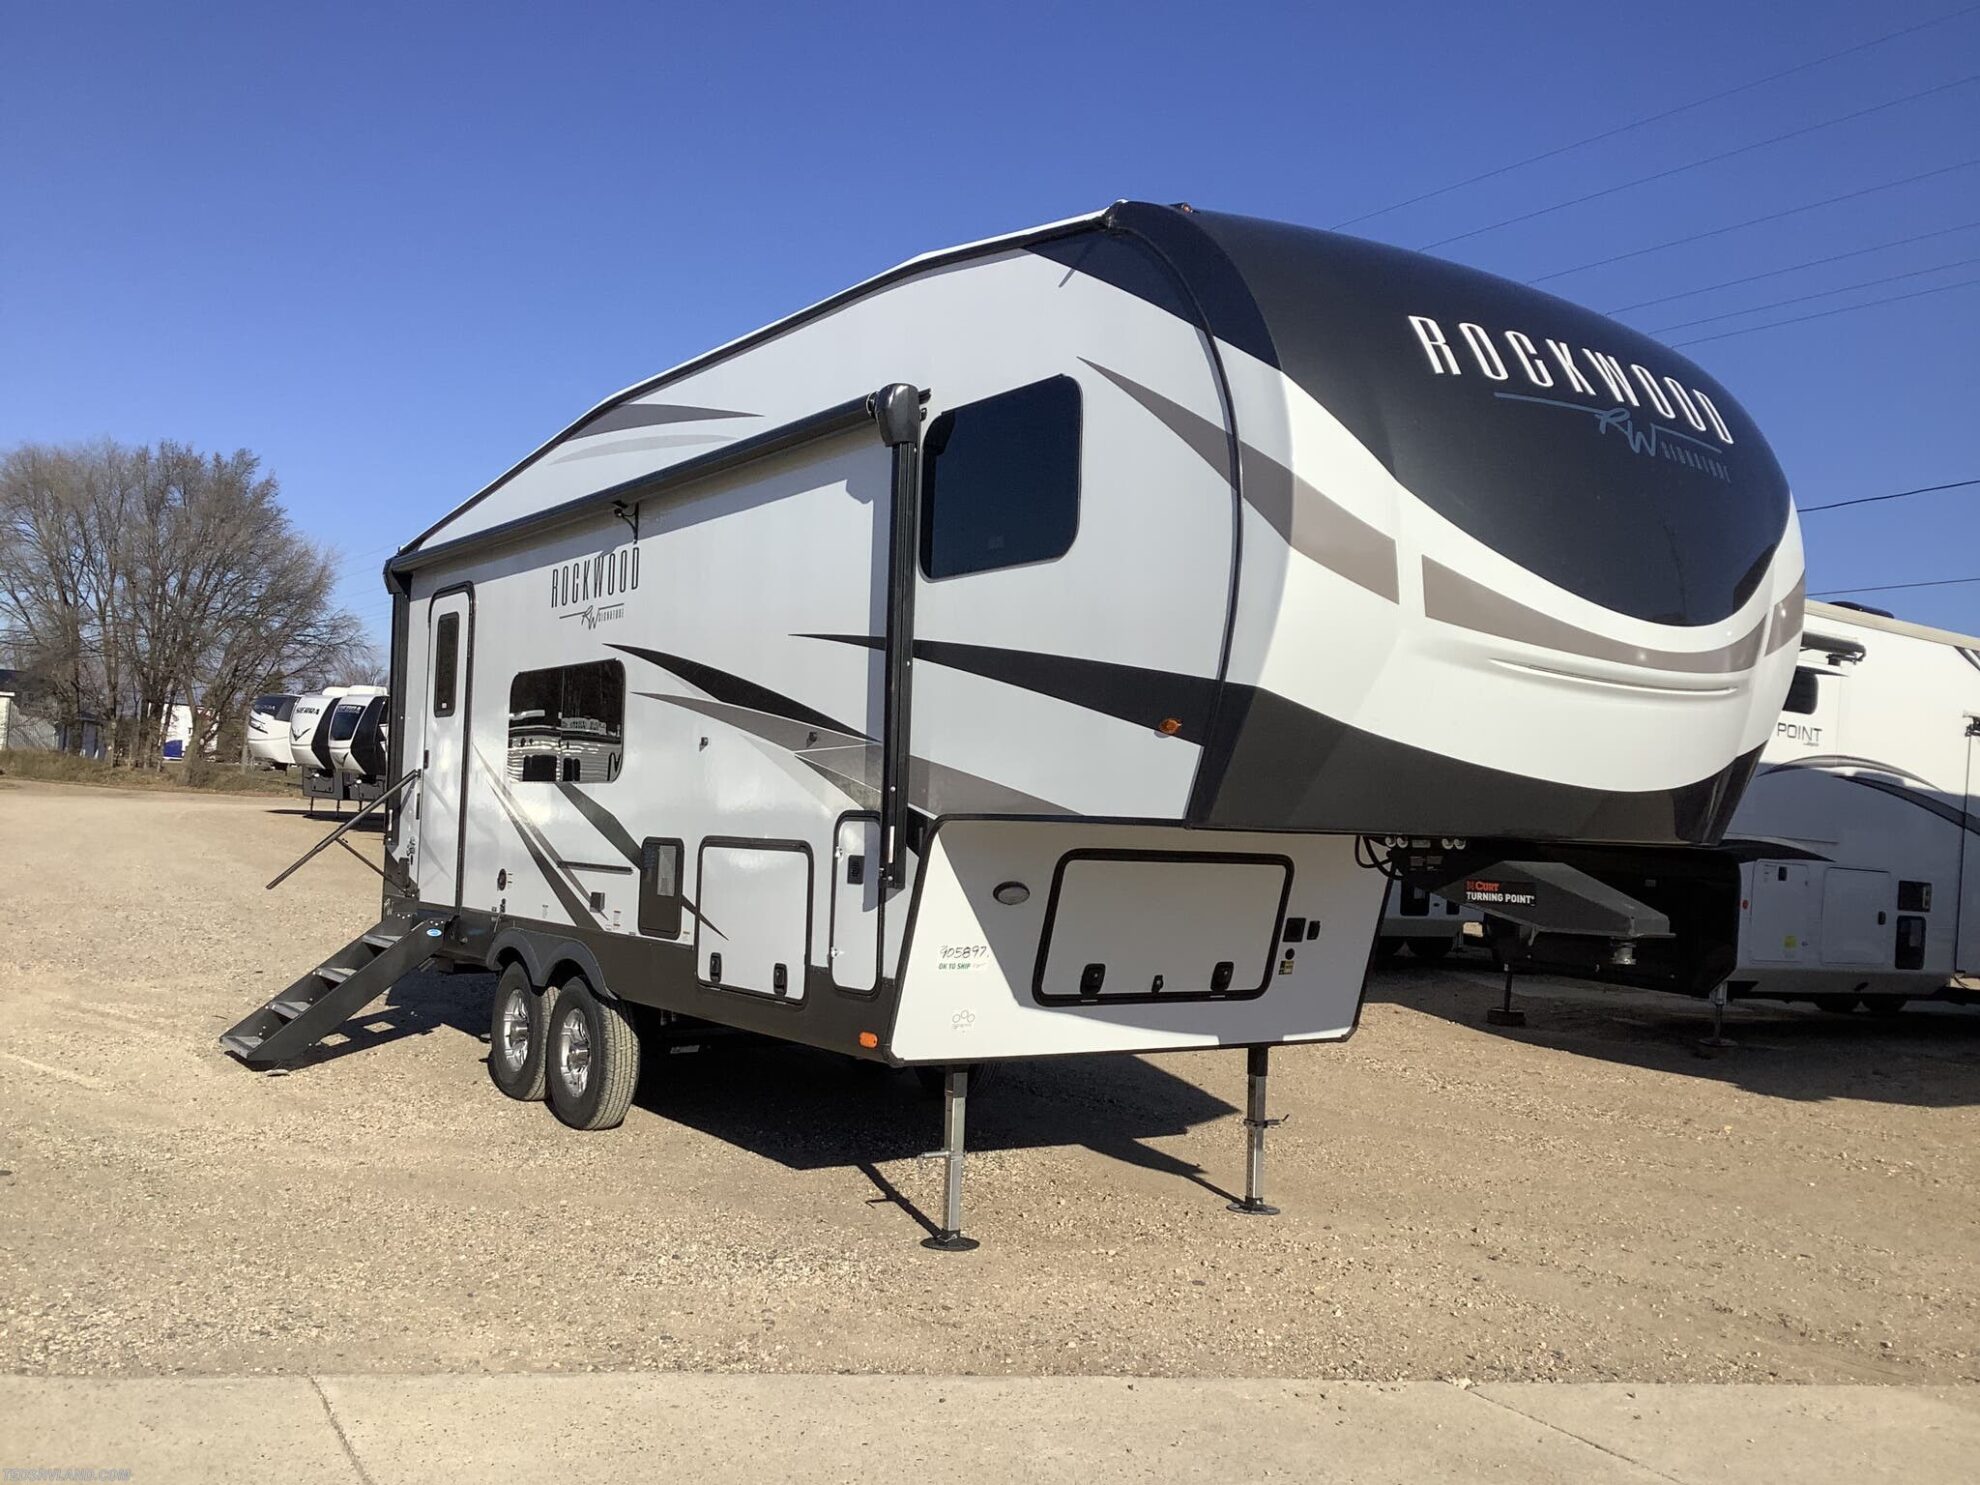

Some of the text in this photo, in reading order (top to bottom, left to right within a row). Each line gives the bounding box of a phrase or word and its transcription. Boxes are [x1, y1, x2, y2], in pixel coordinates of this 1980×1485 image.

[1408, 315, 1734, 444] ROCKWOOD
[551, 547, 639, 608] ROCKWOOD
[1777, 722, 1823, 741] POINT
[1466, 891, 1503, 902] TURNING
